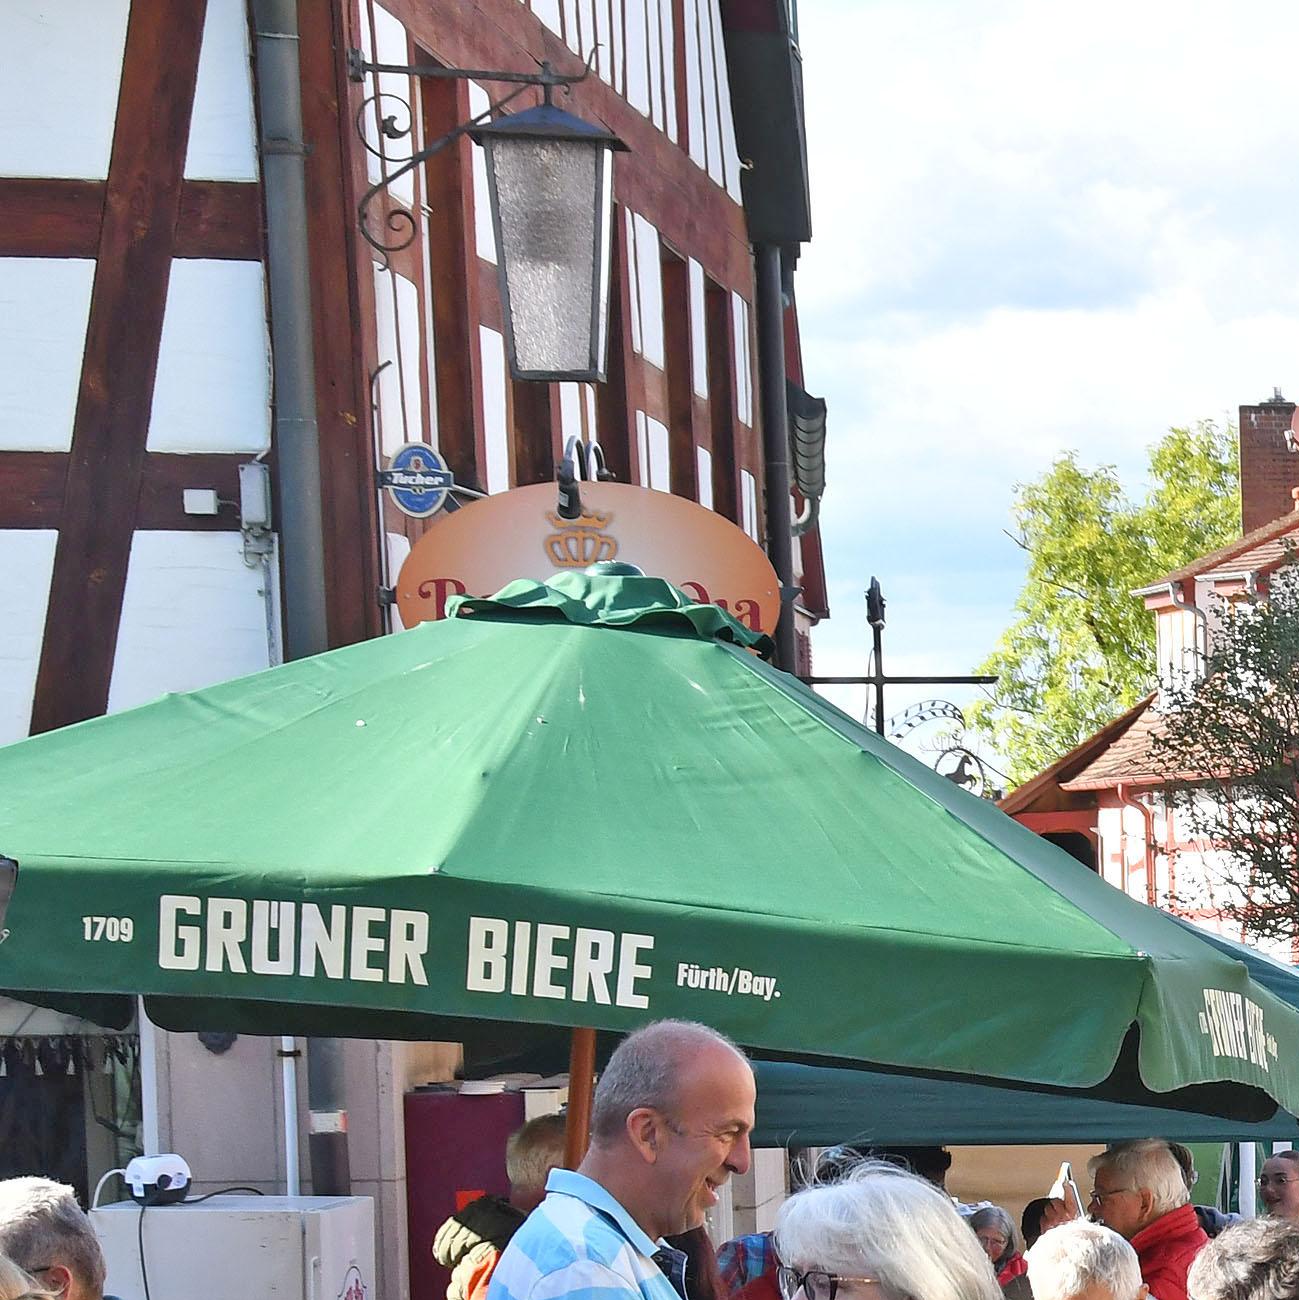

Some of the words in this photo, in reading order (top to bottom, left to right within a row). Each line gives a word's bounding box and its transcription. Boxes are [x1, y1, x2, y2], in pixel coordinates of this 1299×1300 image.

[82, 916, 134, 943] 1709
[157, 894, 431, 987] GRÜNER
[466, 916, 656, 1010] BIERE
[676, 961, 782, 1002] Fürth/Bay.
